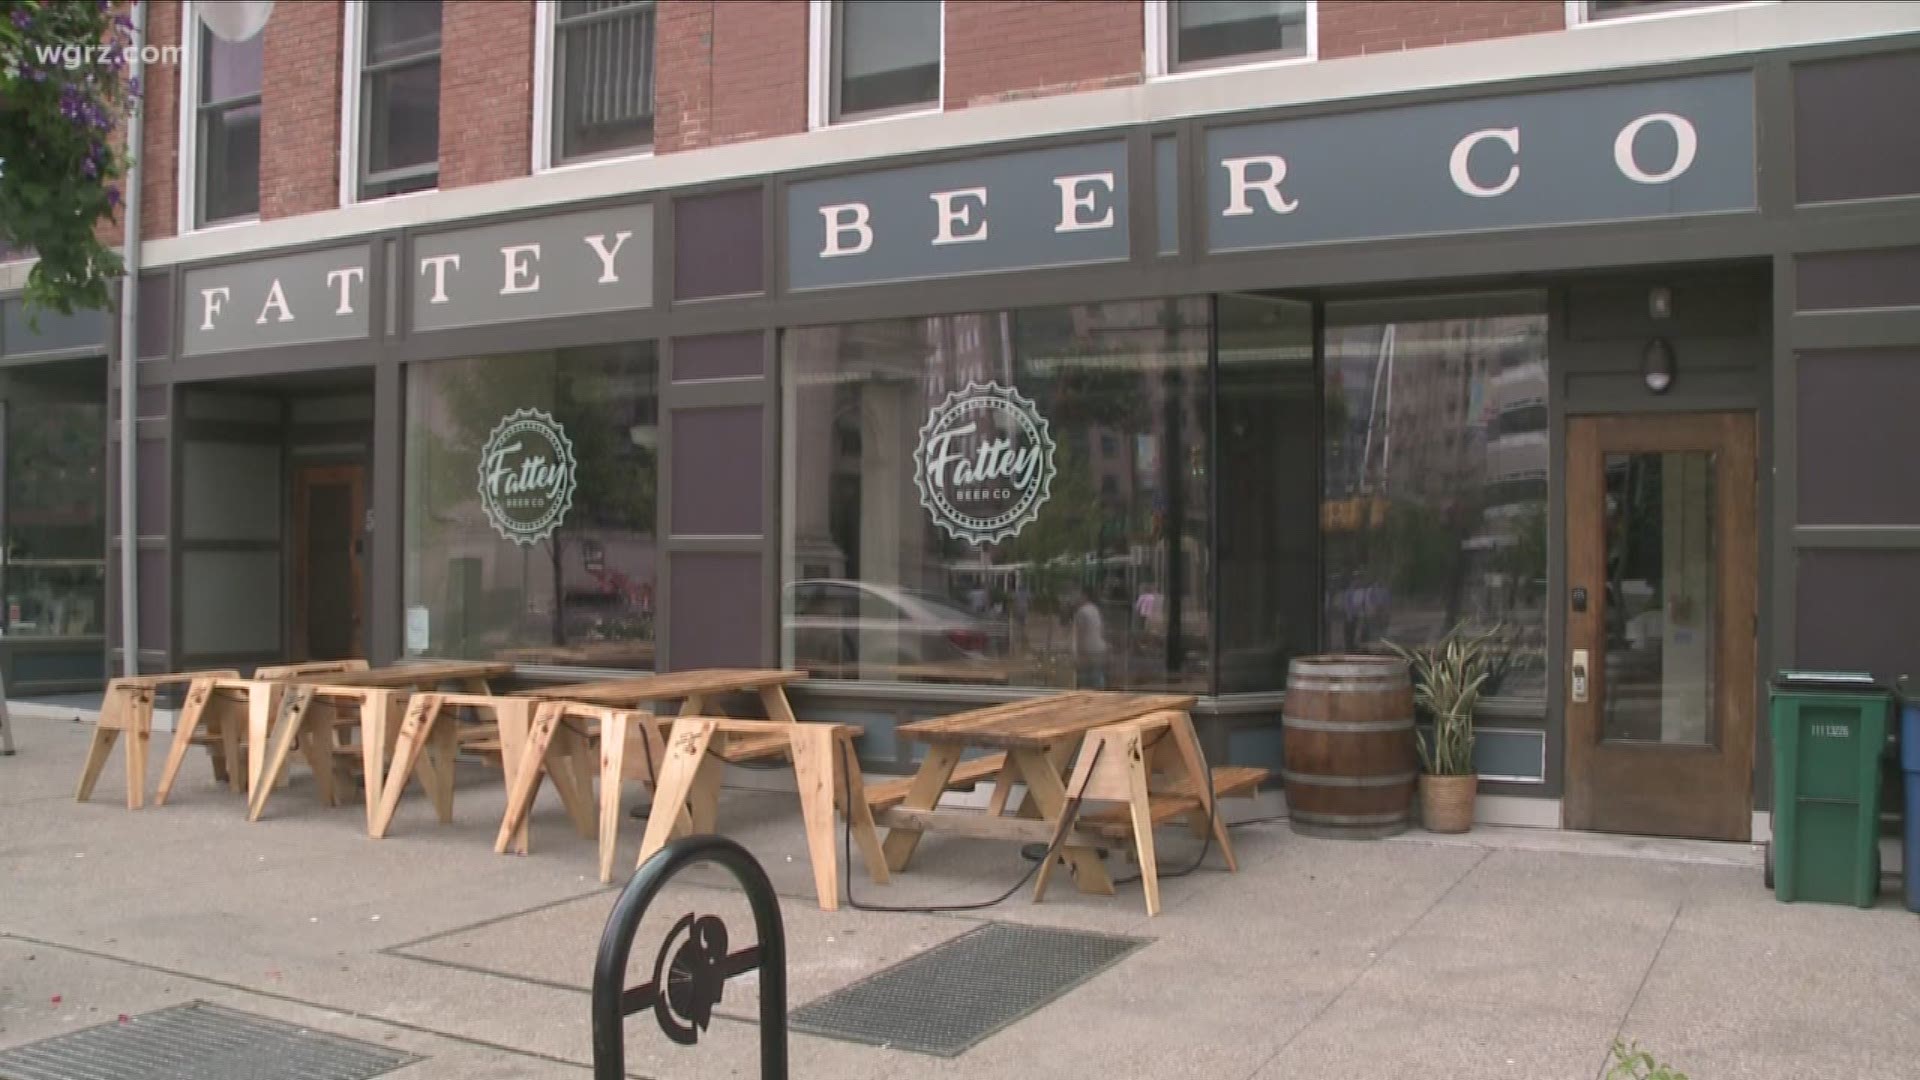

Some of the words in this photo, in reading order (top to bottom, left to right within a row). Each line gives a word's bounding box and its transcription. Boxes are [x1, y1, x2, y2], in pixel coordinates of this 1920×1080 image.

[200, 231, 632, 330] FATTEY
[818, 155, 1298, 258] BEER
[1449, 111, 1698, 198] CO
[487, 441, 568, 499] Fattey
[926, 421, 1041, 490] Fattey
[956, 489, 990, 501] BEER
[993, 488, 1011, 499] CO
